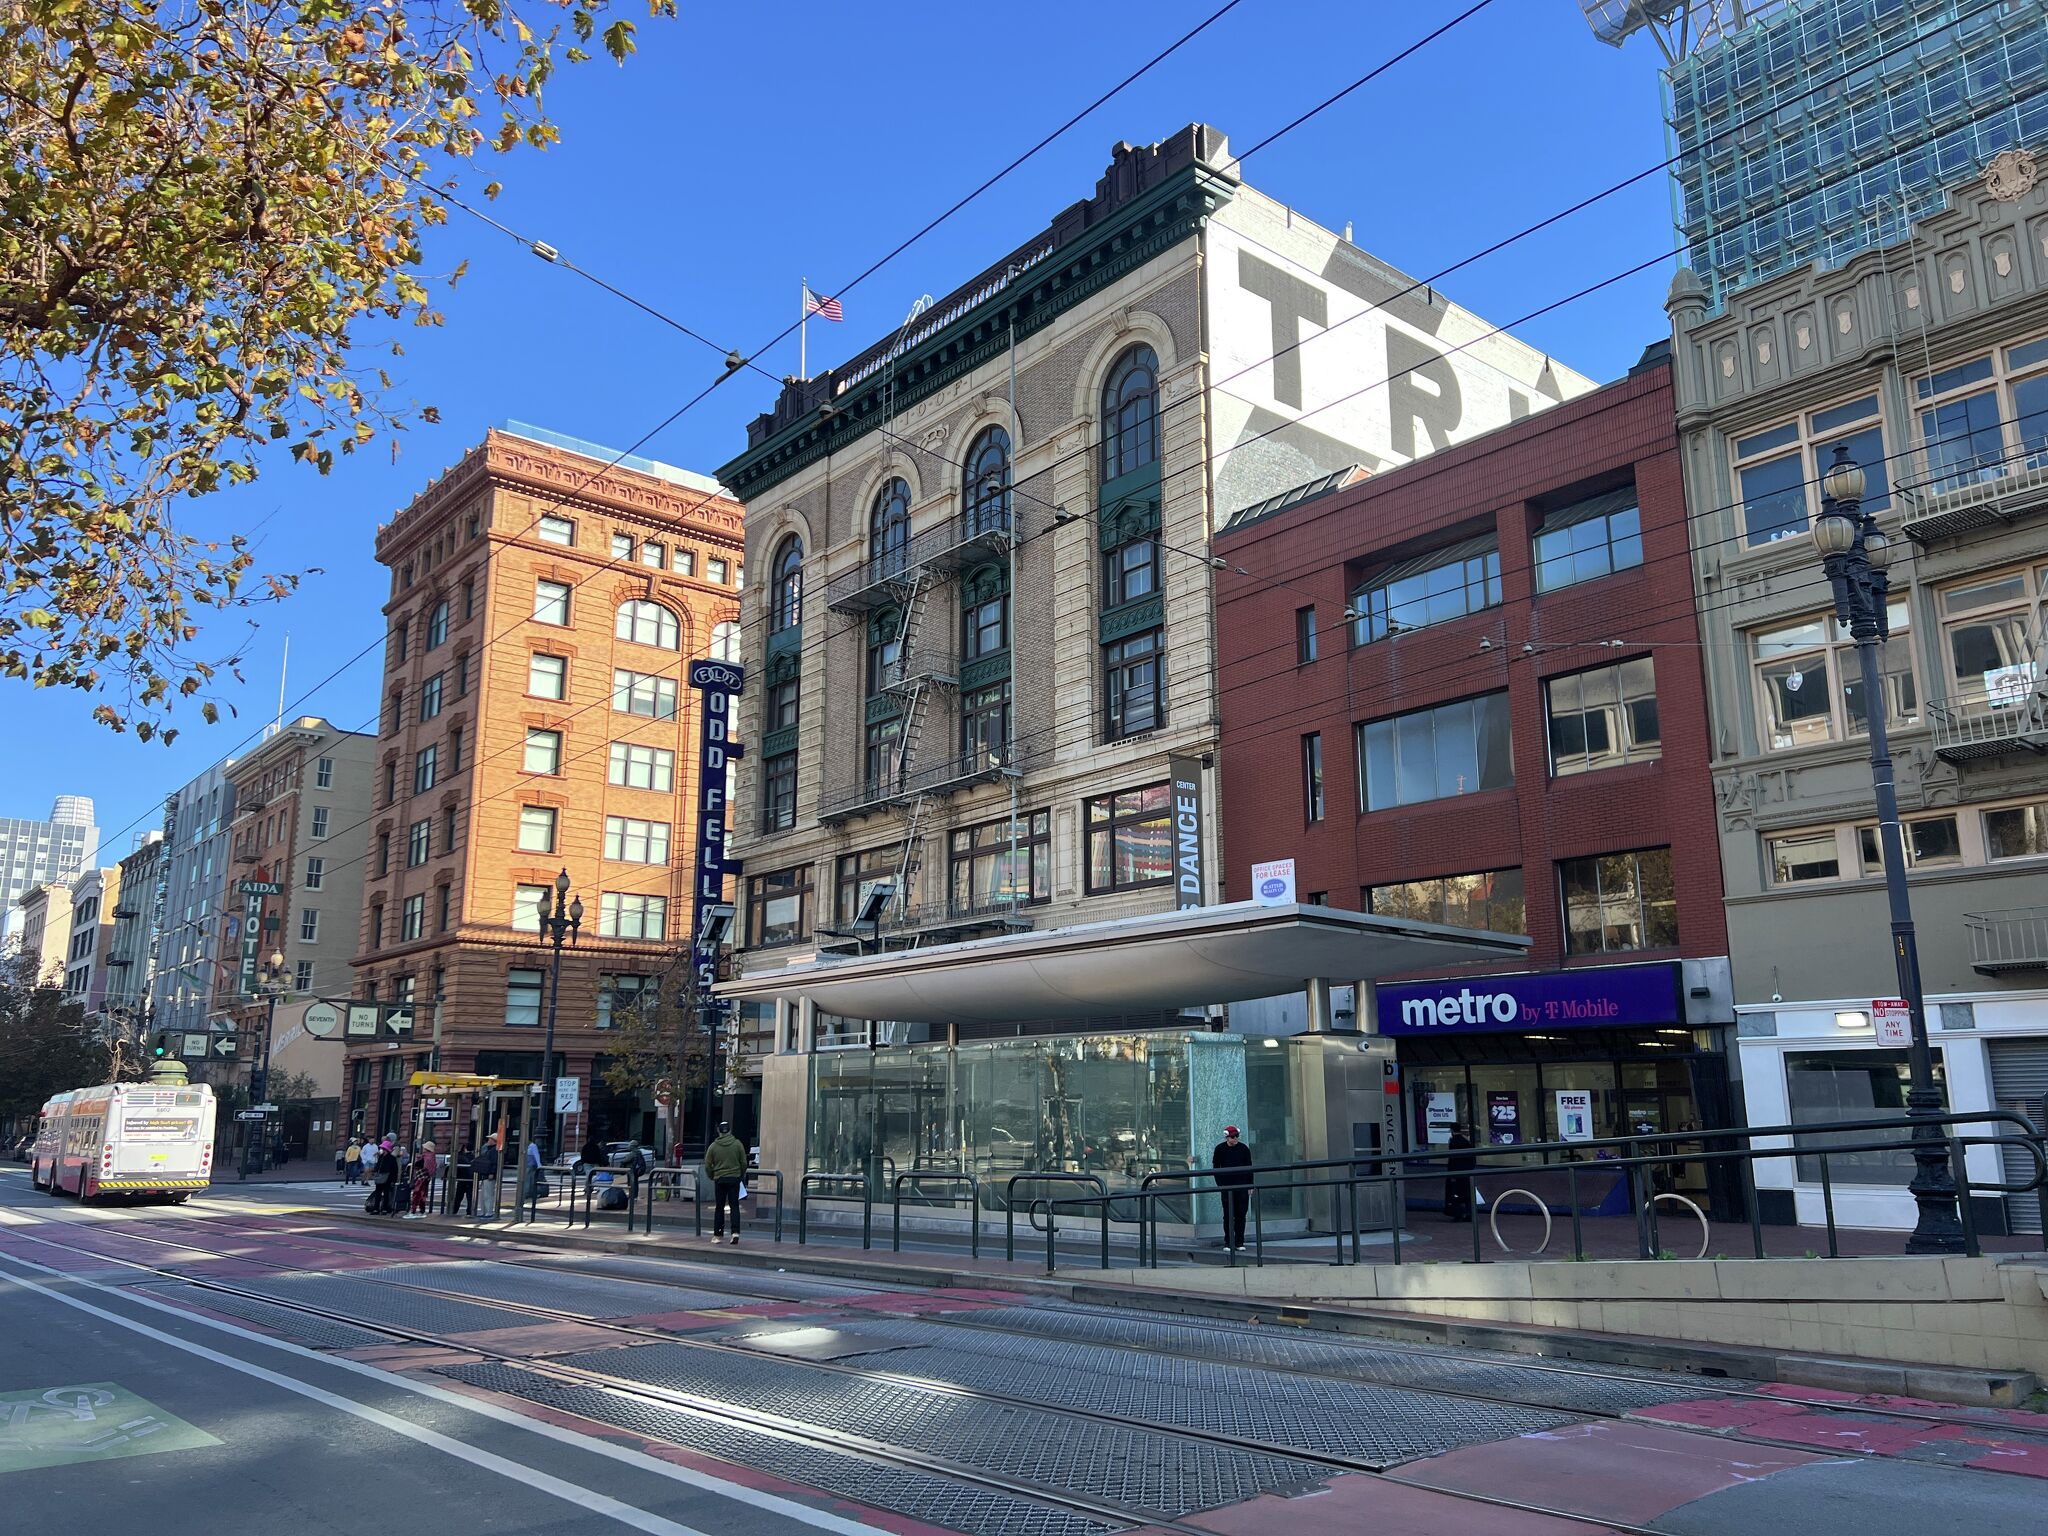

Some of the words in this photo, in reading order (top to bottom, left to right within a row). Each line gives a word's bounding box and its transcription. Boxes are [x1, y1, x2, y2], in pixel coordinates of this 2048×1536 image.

[708, 692, 725, 769] ODD
[1176, 780, 1196, 791] CENTER
[1177, 795, 1200, 895] DANCE
[1270, 869, 1290, 877] LEASE
[242, 882, 279, 894] AIDA
[240, 895, 262, 994] HOTEL
[1401, 988, 1518, 1027] metro
[1521, 1003, 1542, 1025] by
[1874, 1008, 1885, 1017] NO
[1886, 1009, 1910, 1017] STOPPING
[352, 1021, 375, 1029] TURNS
[1885, 1021, 1901, 1029] ANY
[1560, 1096, 1586, 1105] FREE
[1491, 1105, 1517, 1120] $25
[1385, 1104, 1395, 1143] CIVIC
